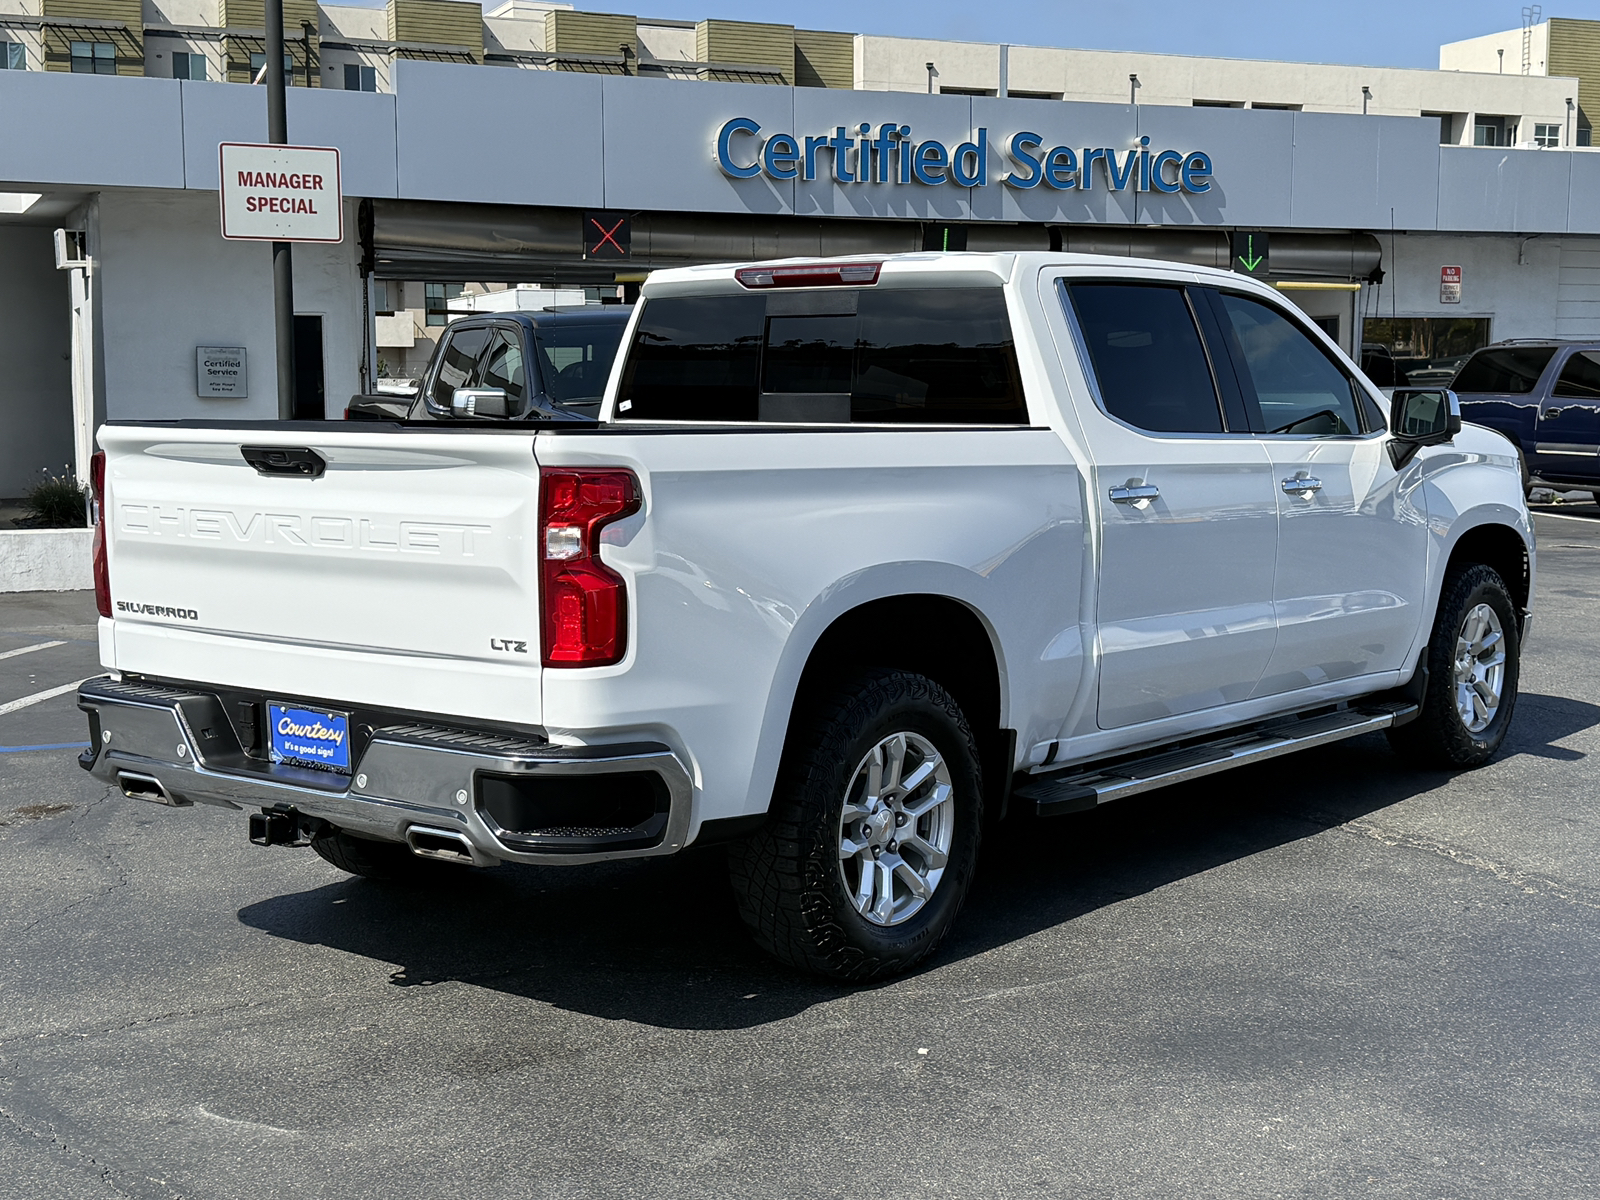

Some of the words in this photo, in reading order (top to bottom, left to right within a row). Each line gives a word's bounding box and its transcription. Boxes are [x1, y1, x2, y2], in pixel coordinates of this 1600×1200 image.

[714, 117, 988, 187] Certified
[1002, 131, 1213, 194] Service
[238, 171, 323, 190] MANAGER
[246, 196, 318, 214] SPECIAL
[207, 368, 238, 376] Service
[120, 504, 492, 557] CHEVROLET
[116, 601, 199, 620] SILVERADO
[490, 638, 528, 653] LTZ
[278, 717, 344, 747] Courtesy
[284, 741, 294, 751] It's
[299, 745, 317, 755] good
